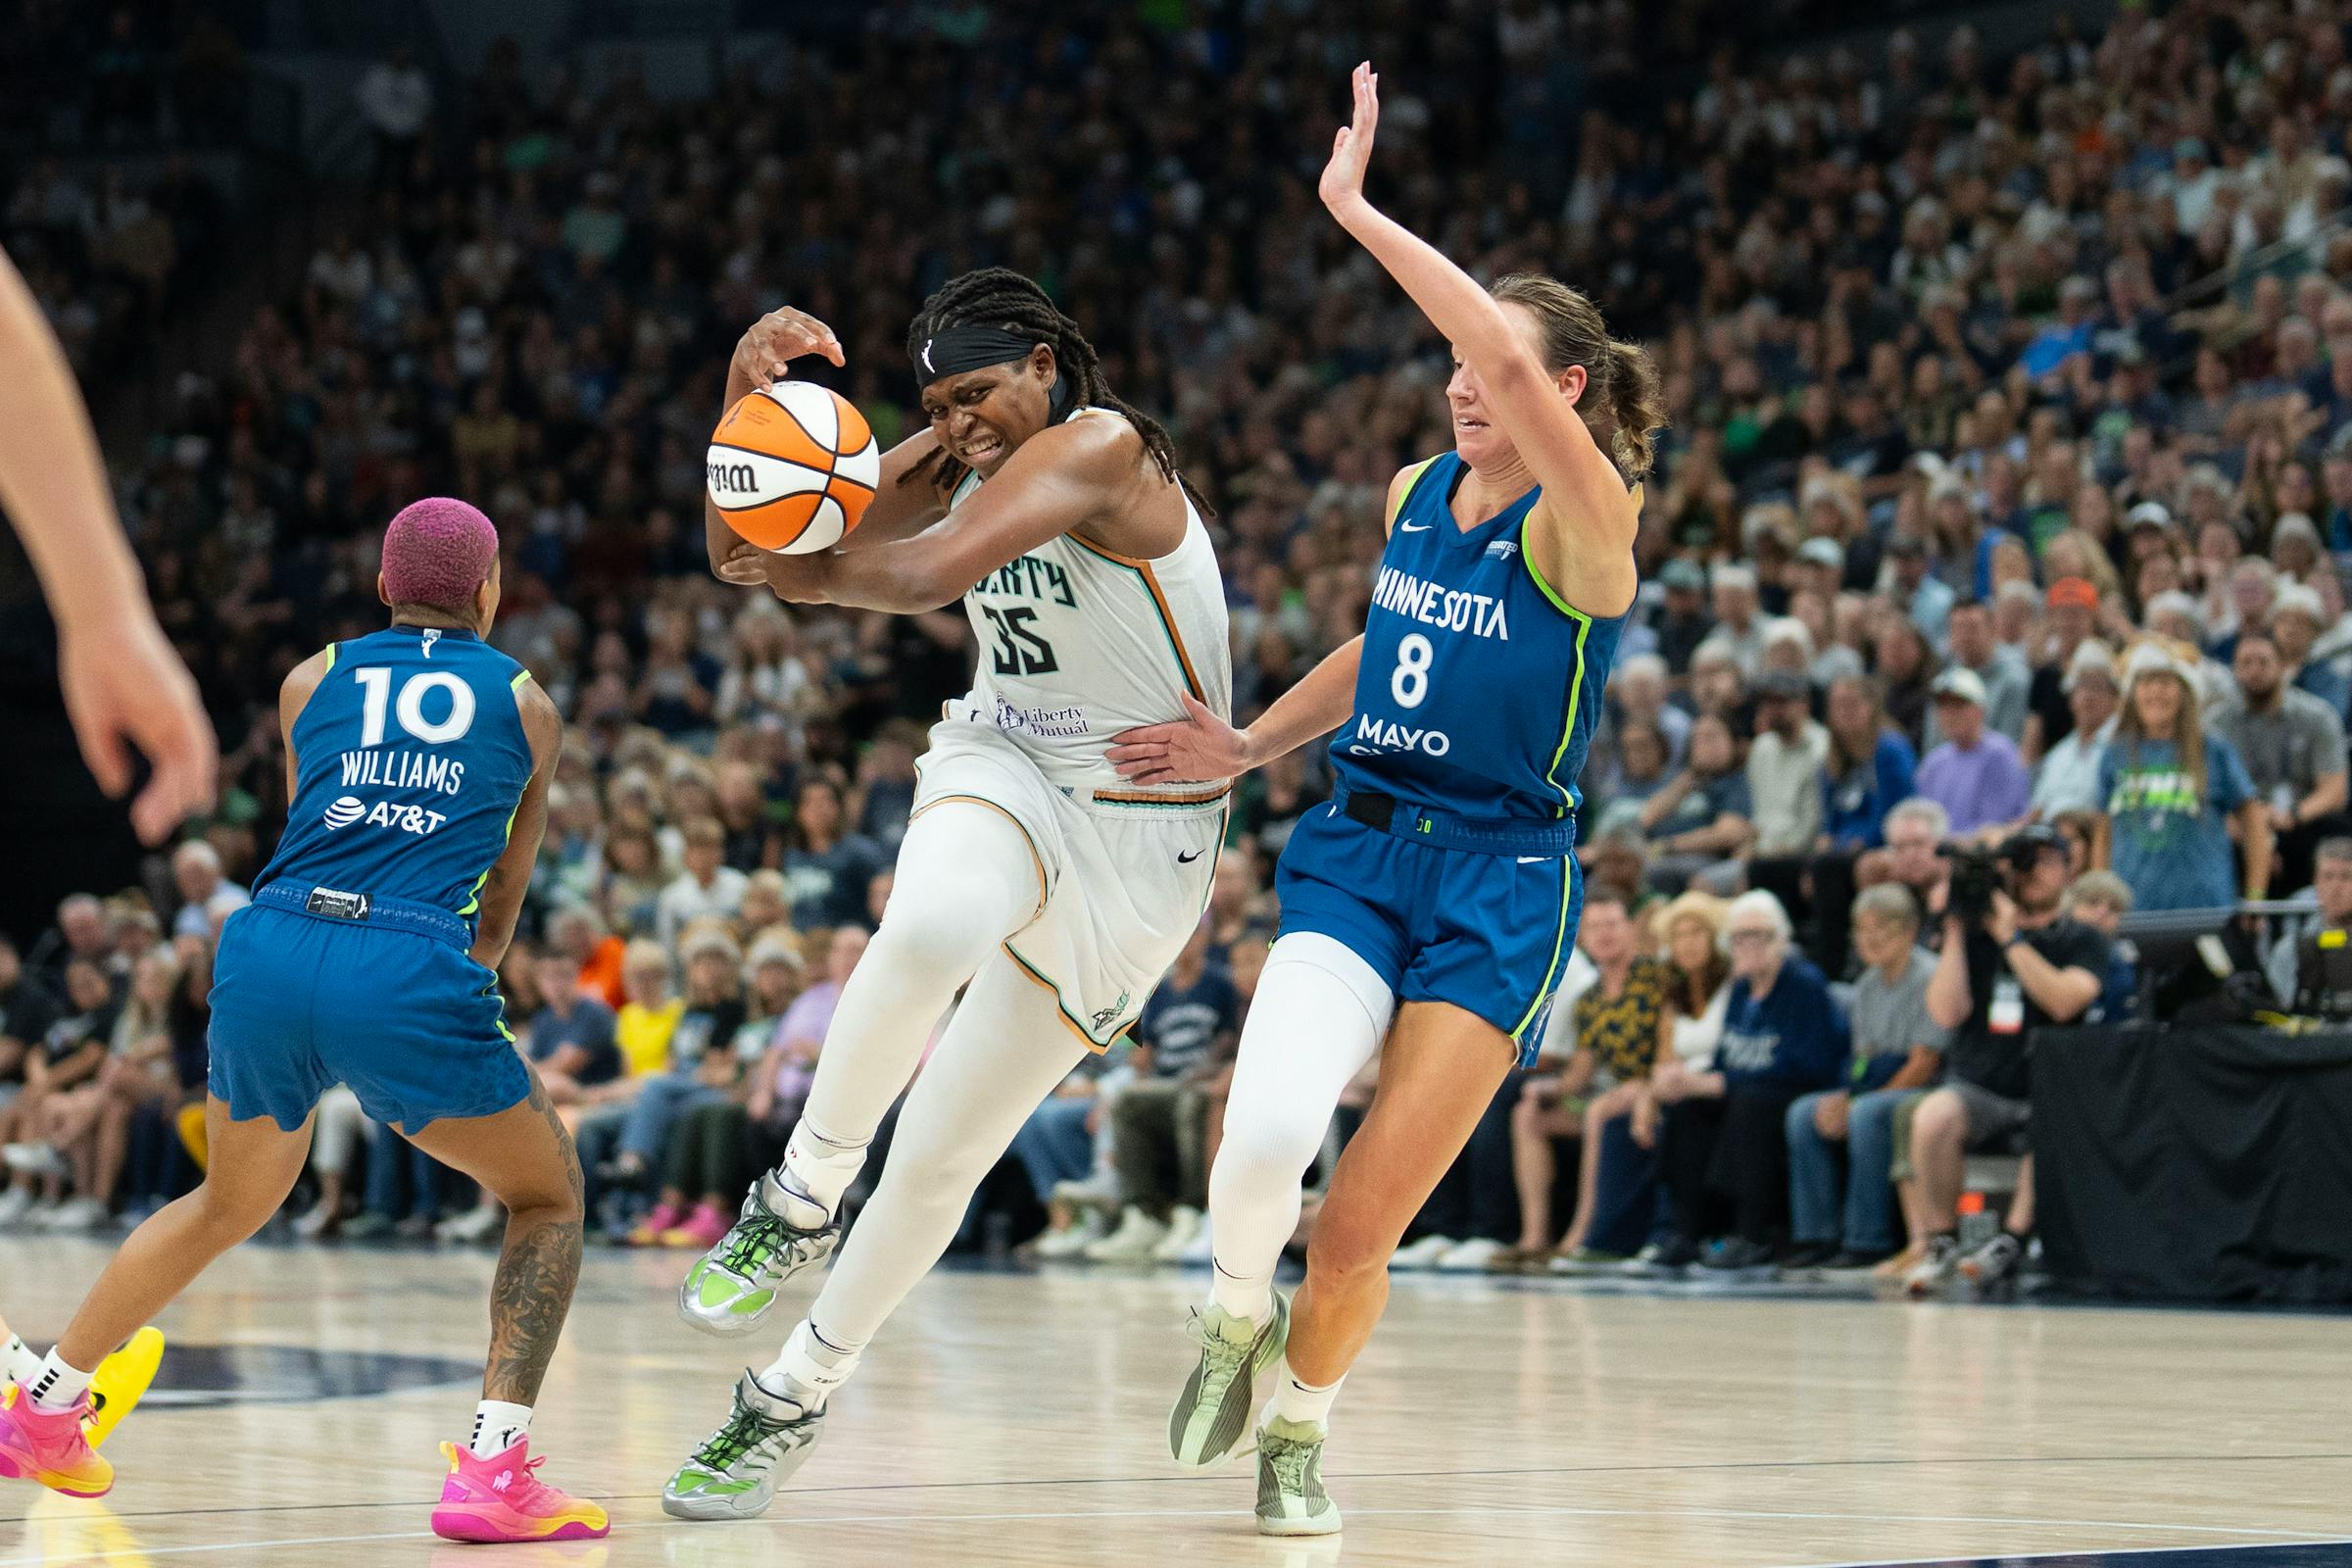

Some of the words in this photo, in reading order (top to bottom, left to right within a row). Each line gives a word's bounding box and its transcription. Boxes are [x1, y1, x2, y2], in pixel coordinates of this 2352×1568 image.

[707, 463, 760, 493] Wils
[1371, 564, 1509, 641] MINNESOTA
[981, 604, 1060, 676] 35
[1391, 633, 1434, 709] 8
[355, 667, 476, 748] 10
[1023, 706, 1084, 725] Liberty
[1026, 719, 1090, 737] Mutual
[1356, 712, 1450, 756] MAYO
[341, 751, 465, 796] WILLIAMS
[366, 801, 447, 835] AT&T
